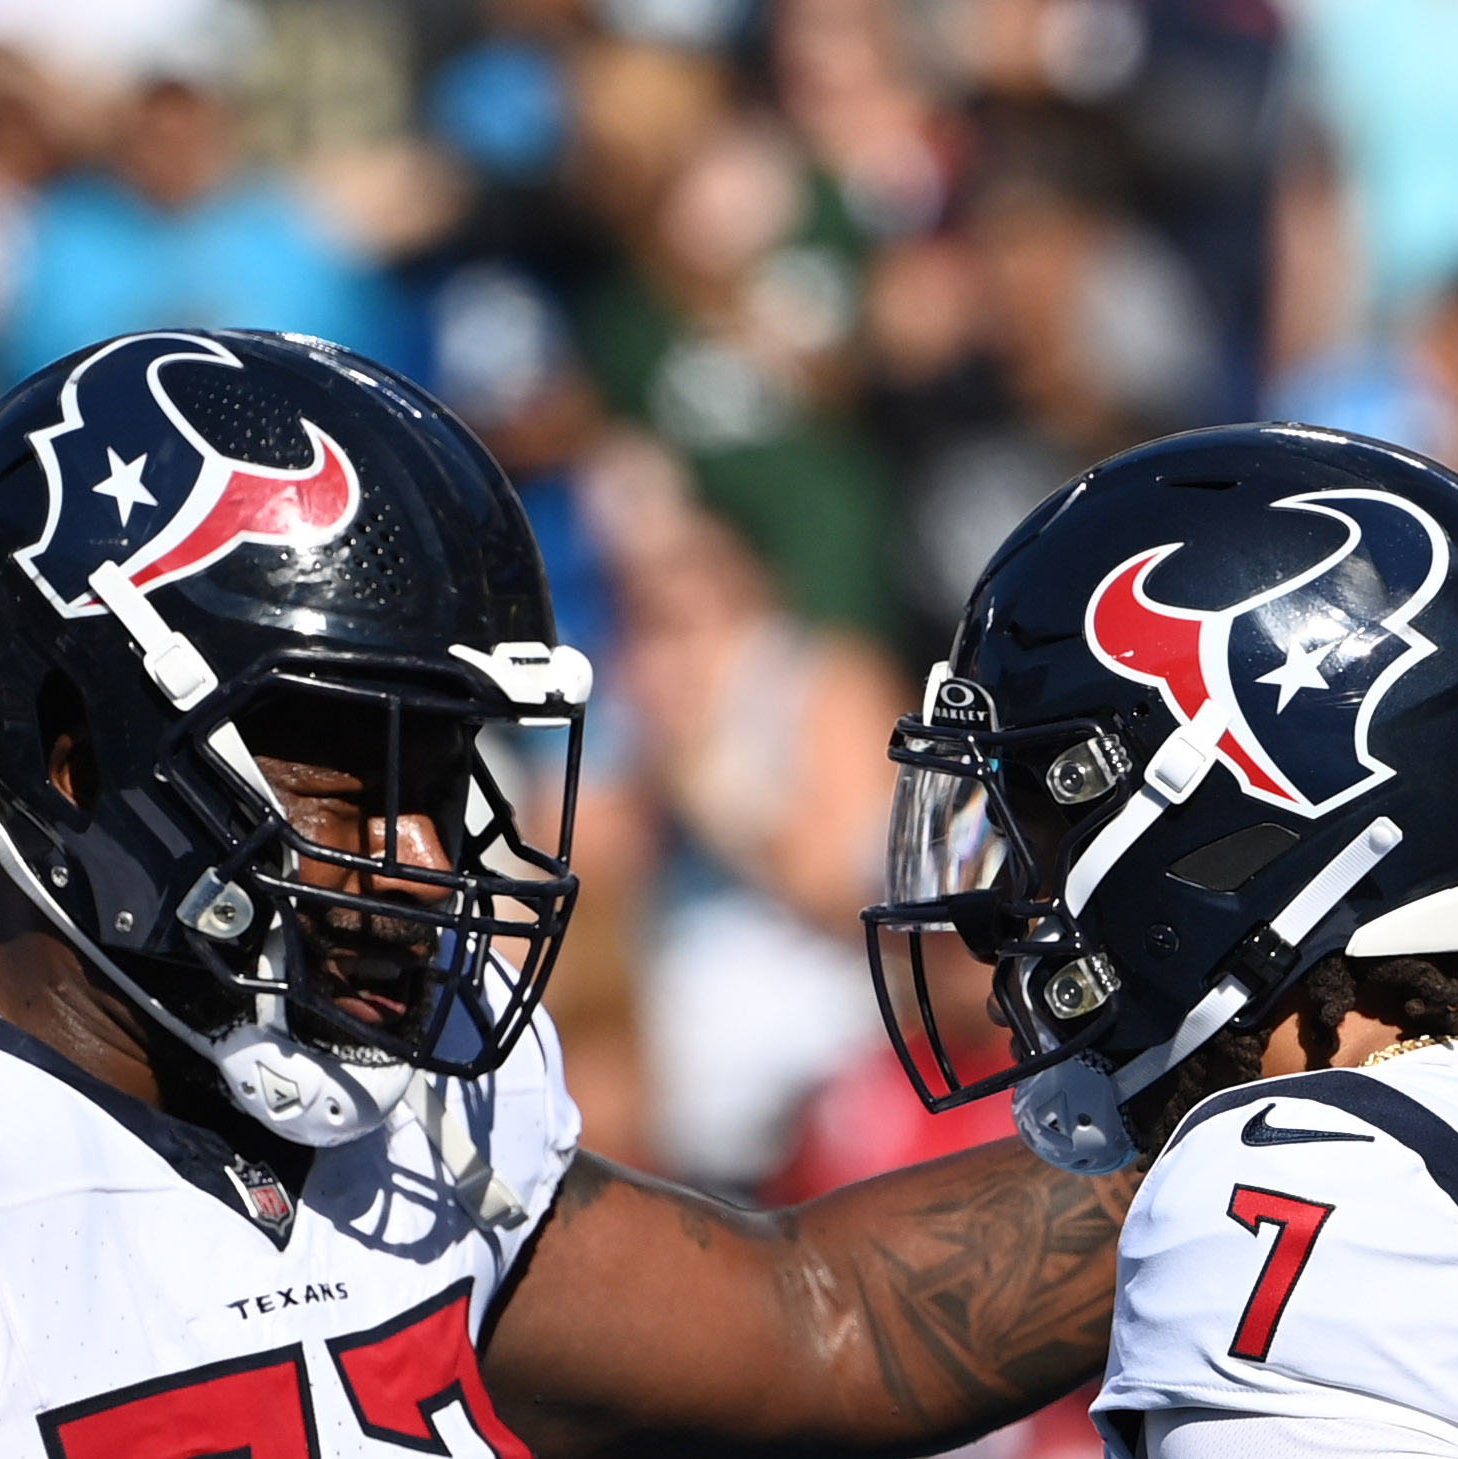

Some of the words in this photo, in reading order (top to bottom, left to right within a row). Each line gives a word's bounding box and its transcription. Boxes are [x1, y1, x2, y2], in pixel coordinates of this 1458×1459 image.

[934, 706, 988, 721] OAKLEY
[1226, 1183, 1336, 1363] 7
[226, 1282, 349, 1320] TEXANS
